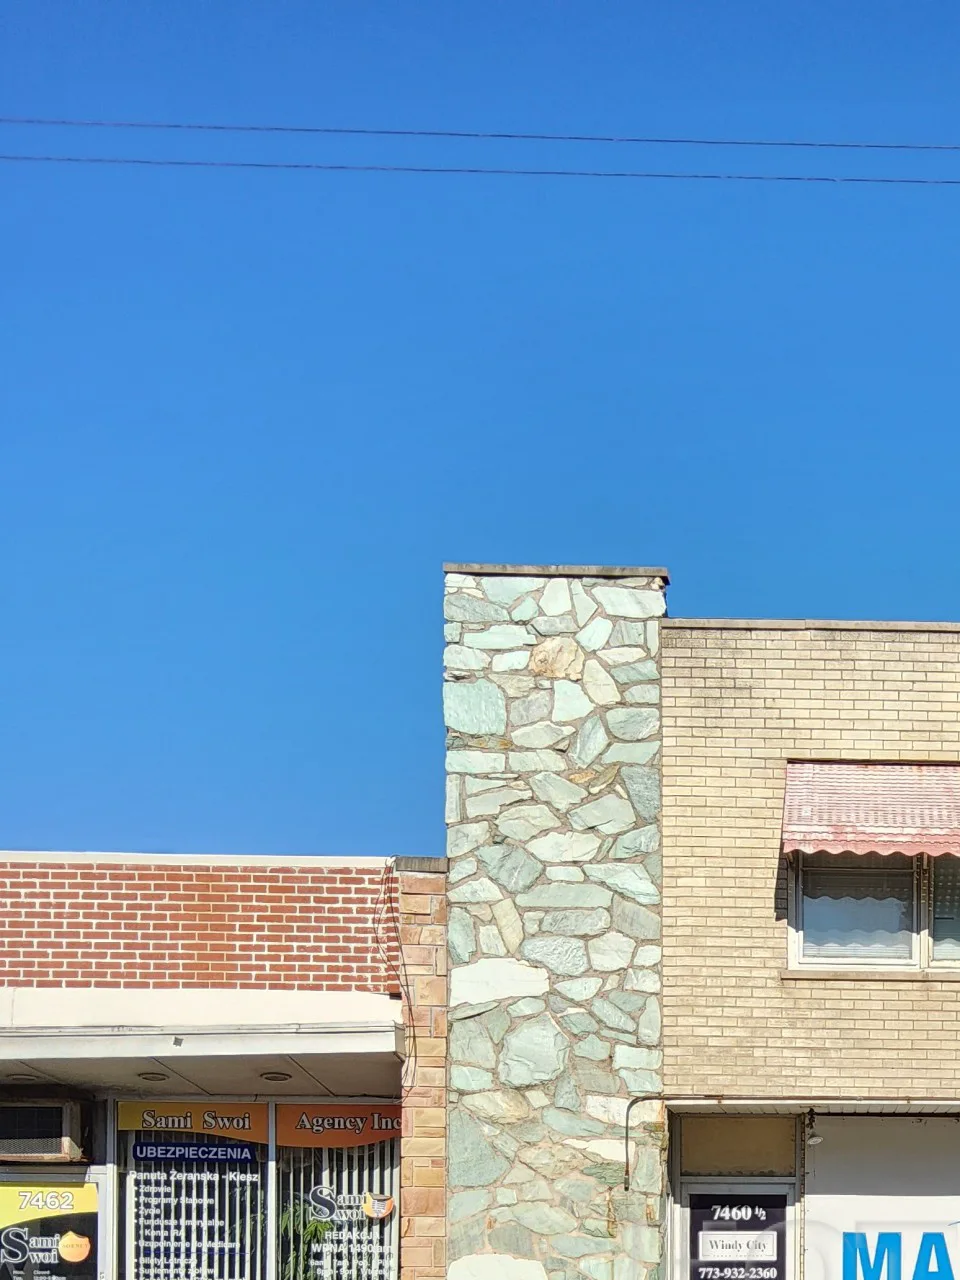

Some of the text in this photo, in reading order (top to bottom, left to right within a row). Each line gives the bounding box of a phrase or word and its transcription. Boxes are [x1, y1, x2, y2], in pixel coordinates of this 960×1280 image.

[142, 1110, 192, 1129] Sami
[203, 1111, 251, 1130] Swoi
[295, 1112, 367, 1134] Agency
[136, 1146, 251, 1160] UBEZPIECZENIA
[19, 1191, 74, 1209] 7462
[711, 1205, 752, 1220] 7460
[709, 1240, 767, 1252] Windy City
[699, 1267, 777, 1279] 773-932-2360
